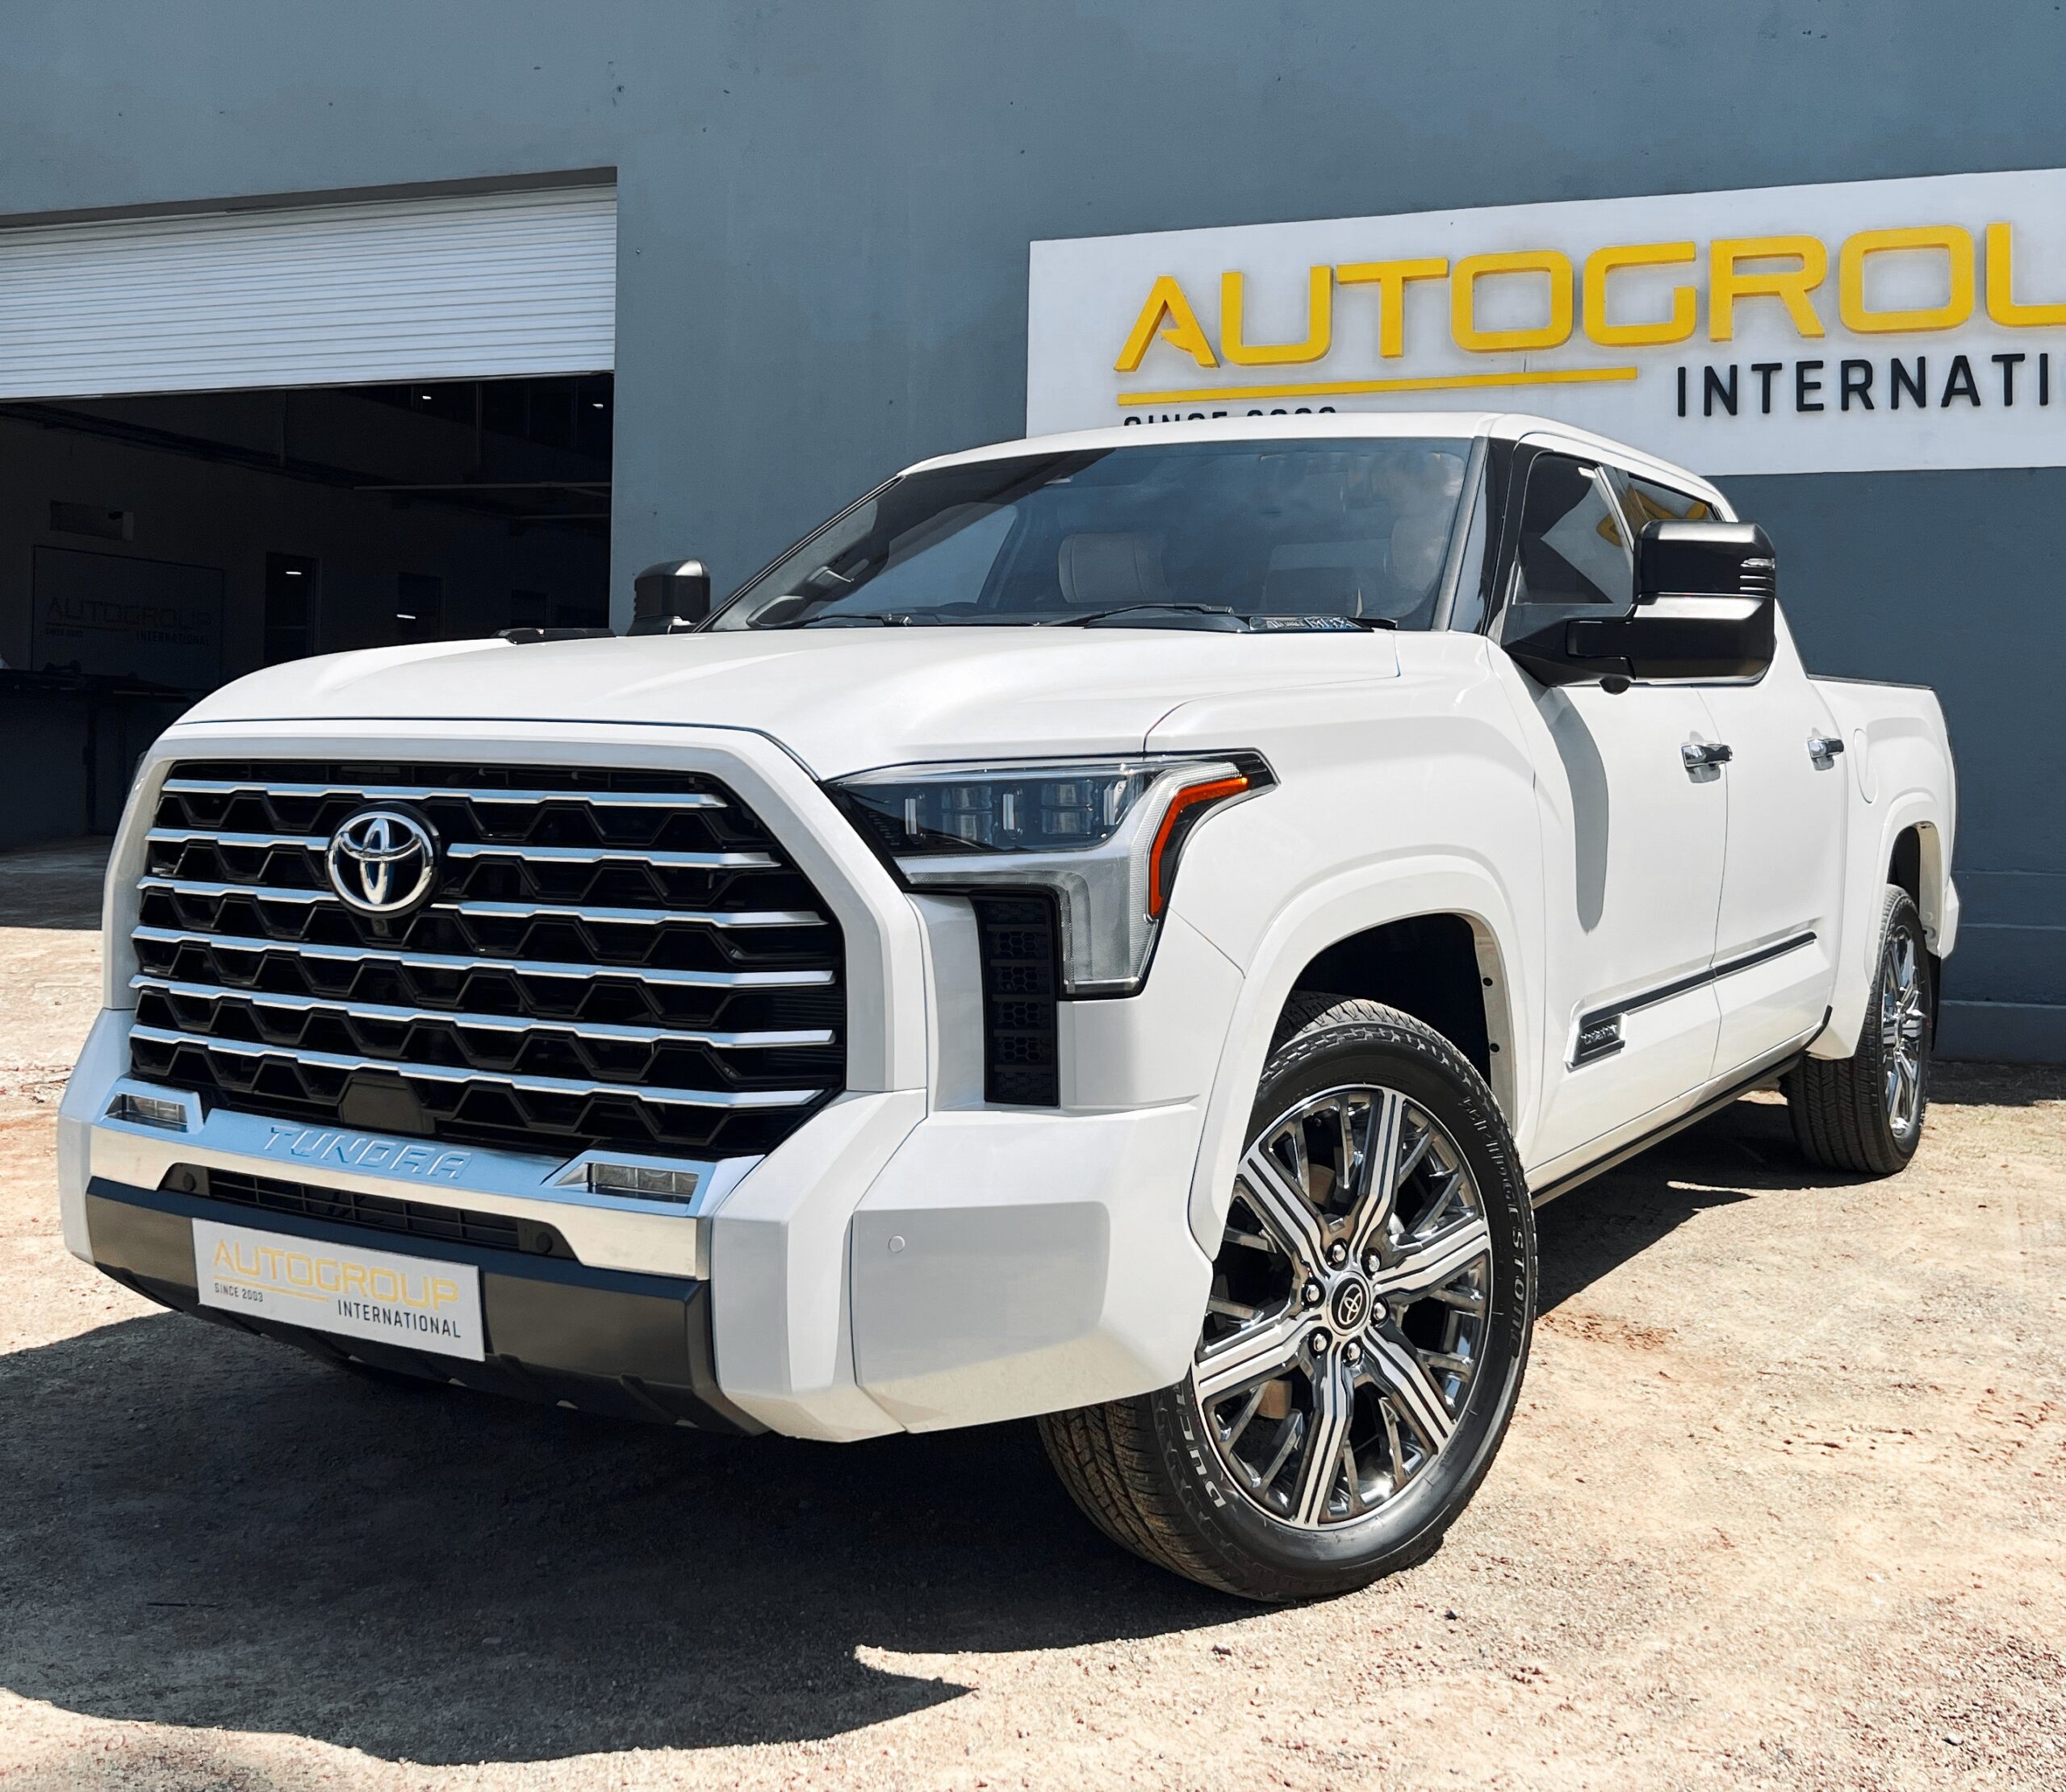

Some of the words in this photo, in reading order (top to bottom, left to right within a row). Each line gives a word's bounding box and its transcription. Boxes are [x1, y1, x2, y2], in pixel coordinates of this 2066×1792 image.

[264, 1125, 473, 1180] TUNDRA
[212, 1239, 459, 1310] AUTOGROUP
[214, 1282, 239, 1297] SINCE
[241, 1288, 263, 1302] 2003
[338, 1300, 461, 1339] INTERNATIONAL
